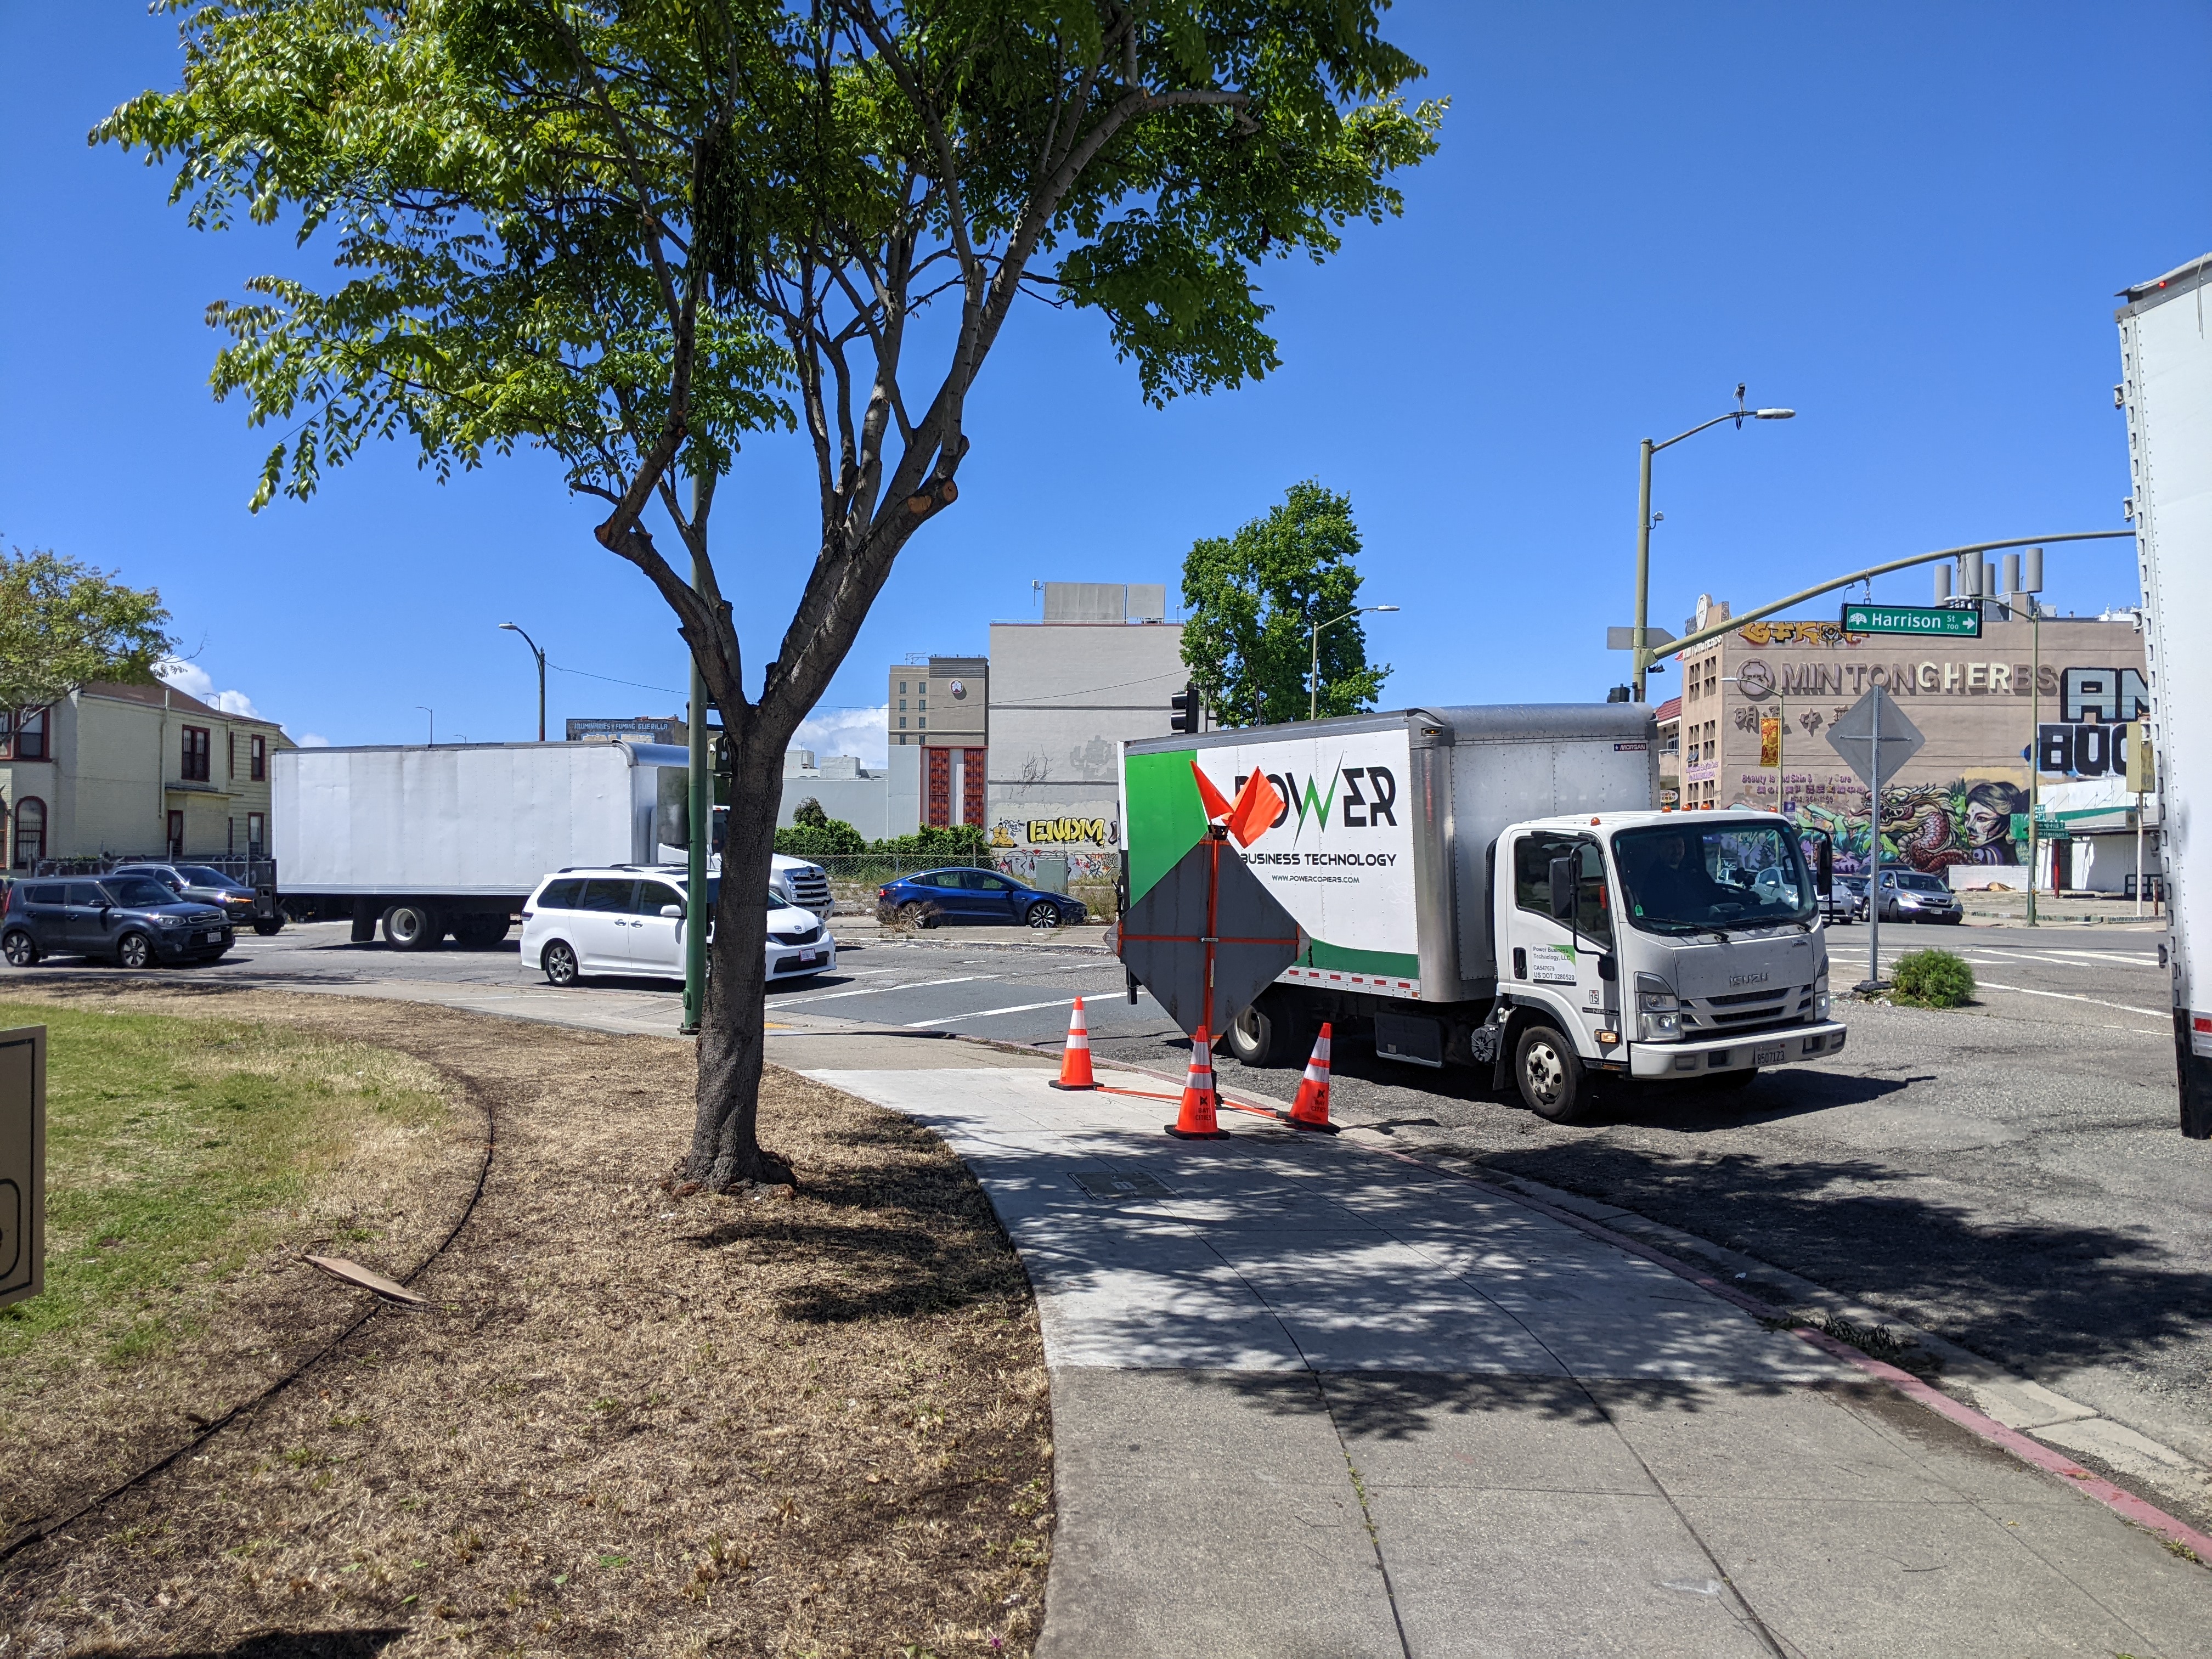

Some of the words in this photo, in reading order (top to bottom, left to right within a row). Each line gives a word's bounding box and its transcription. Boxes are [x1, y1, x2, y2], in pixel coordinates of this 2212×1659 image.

[1872, 613, 1940, 628] Harrison
[1741, 773, 1766, 785] Beauty
[1790, 773, 1807, 783] Skin
[1240, 854, 1300, 865] BUSINESS
[1304, 854, 1397, 866] TECHNOLOGY
[1272, 875, 1359, 884] WWW.POWERCOPIERS.COM
[1729, 972, 1769, 988] ISUZU
[1590, 994, 1598, 1003] 15
